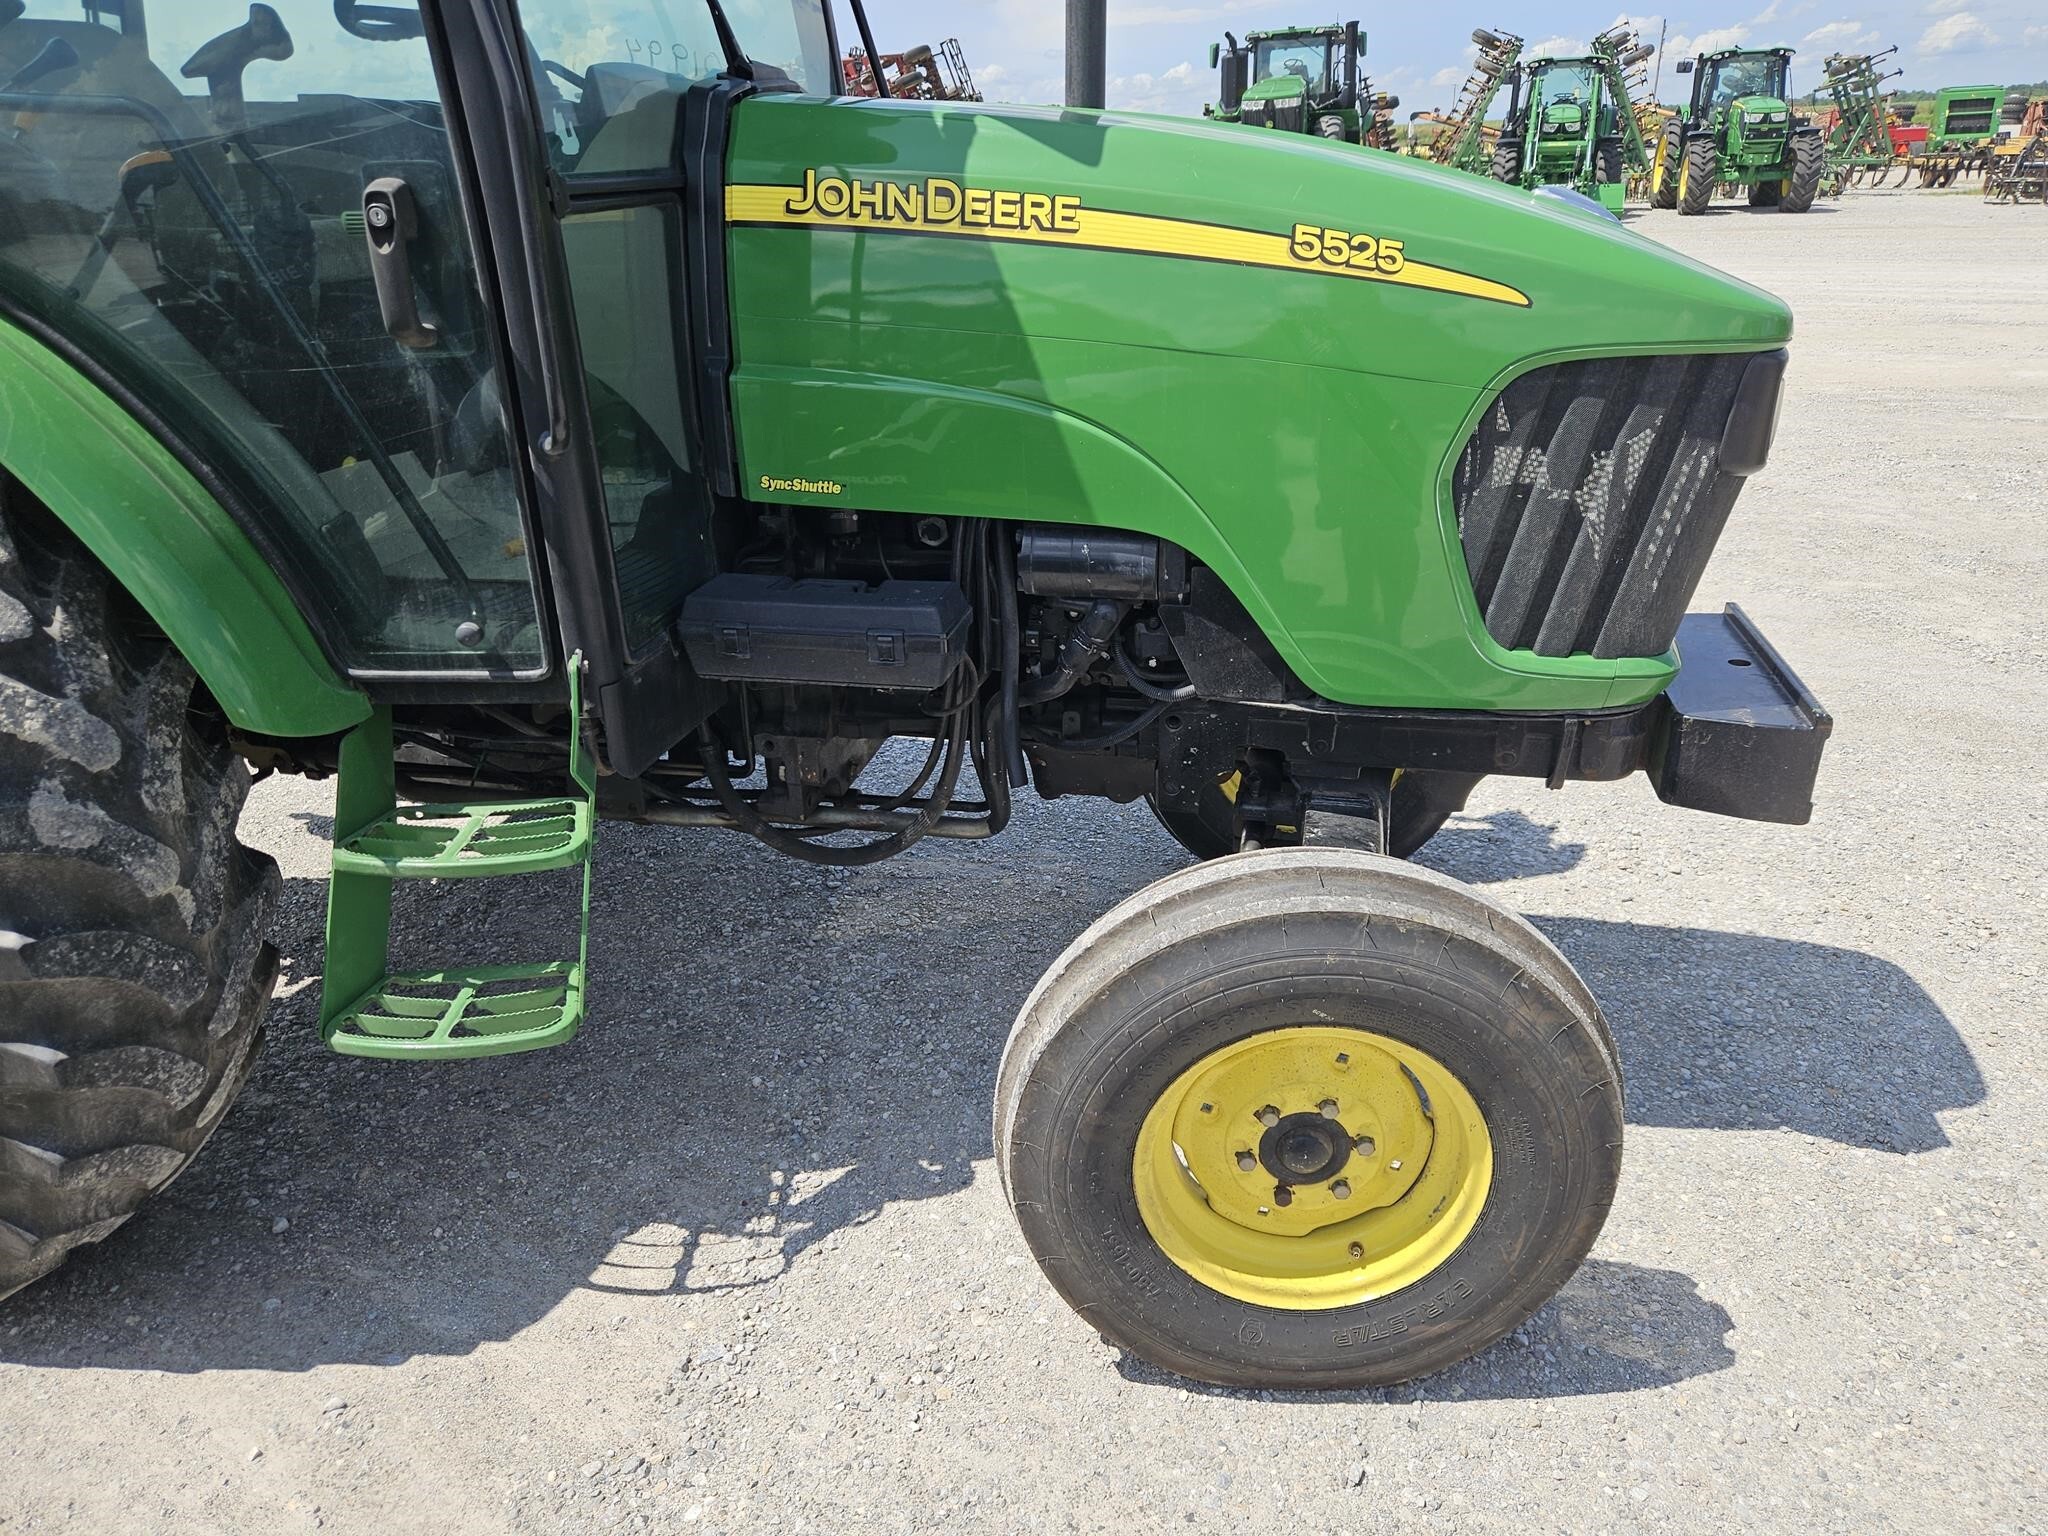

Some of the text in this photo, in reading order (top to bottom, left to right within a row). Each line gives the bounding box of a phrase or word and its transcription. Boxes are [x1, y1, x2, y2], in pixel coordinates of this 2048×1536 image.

[785, 168, 1081, 233] JOHN DEERE
[1290, 222, 1405, 275] 5525
[1333, 1277, 1473, 1347] CARLSTAR
